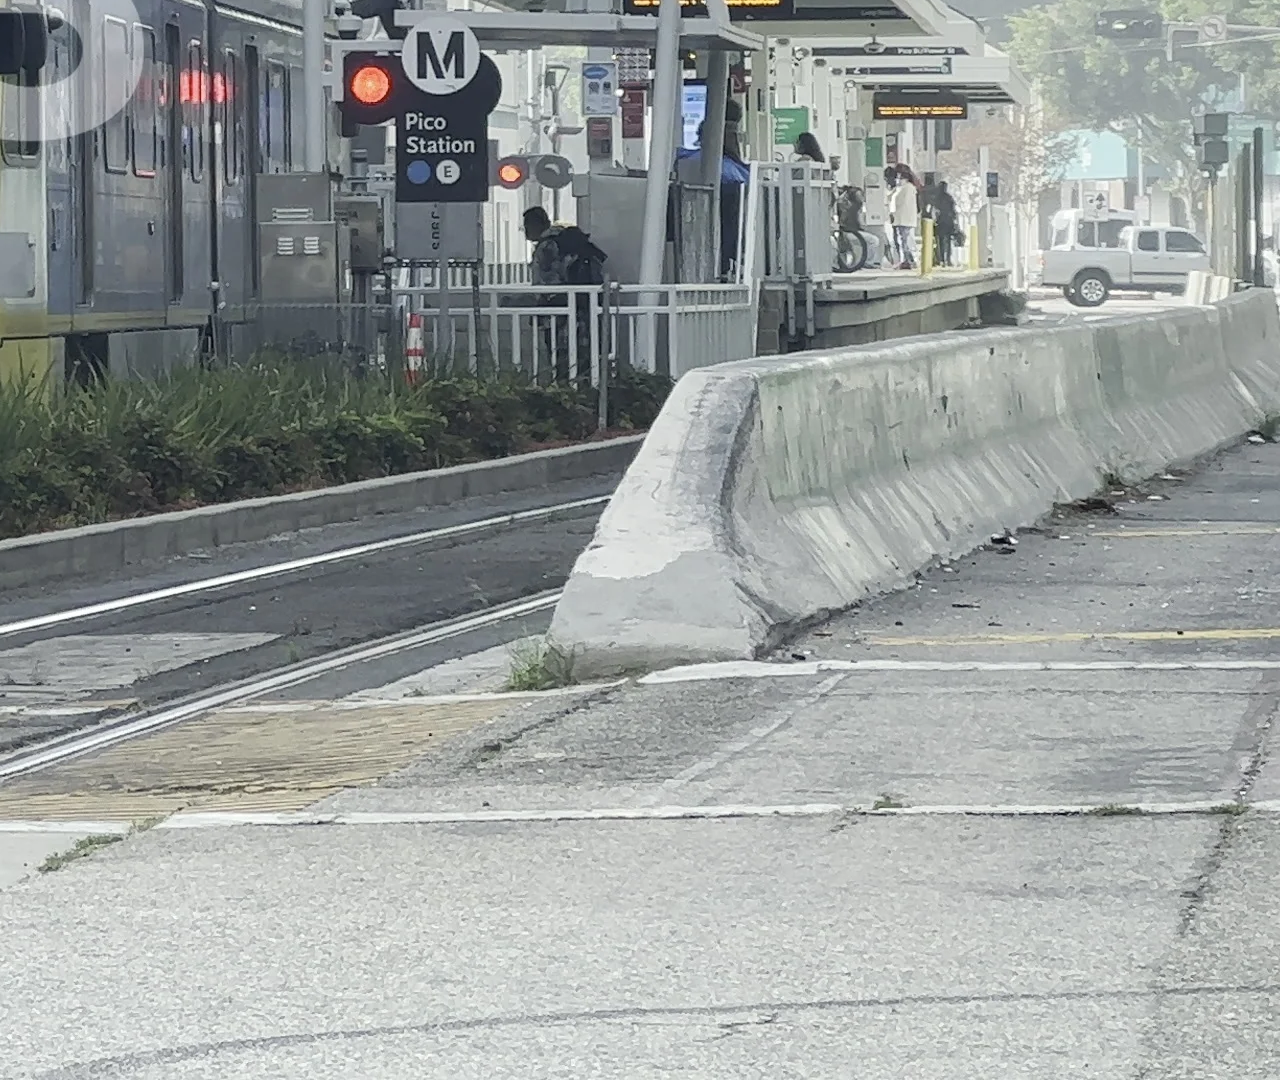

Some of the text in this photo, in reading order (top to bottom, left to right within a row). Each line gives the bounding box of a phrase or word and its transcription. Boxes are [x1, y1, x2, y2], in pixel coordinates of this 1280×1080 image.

[416, 31, 465, 79] M
[405, 113, 447, 131] Pico
[406, 136, 476, 154] Station
[443, 165, 453, 178] E
